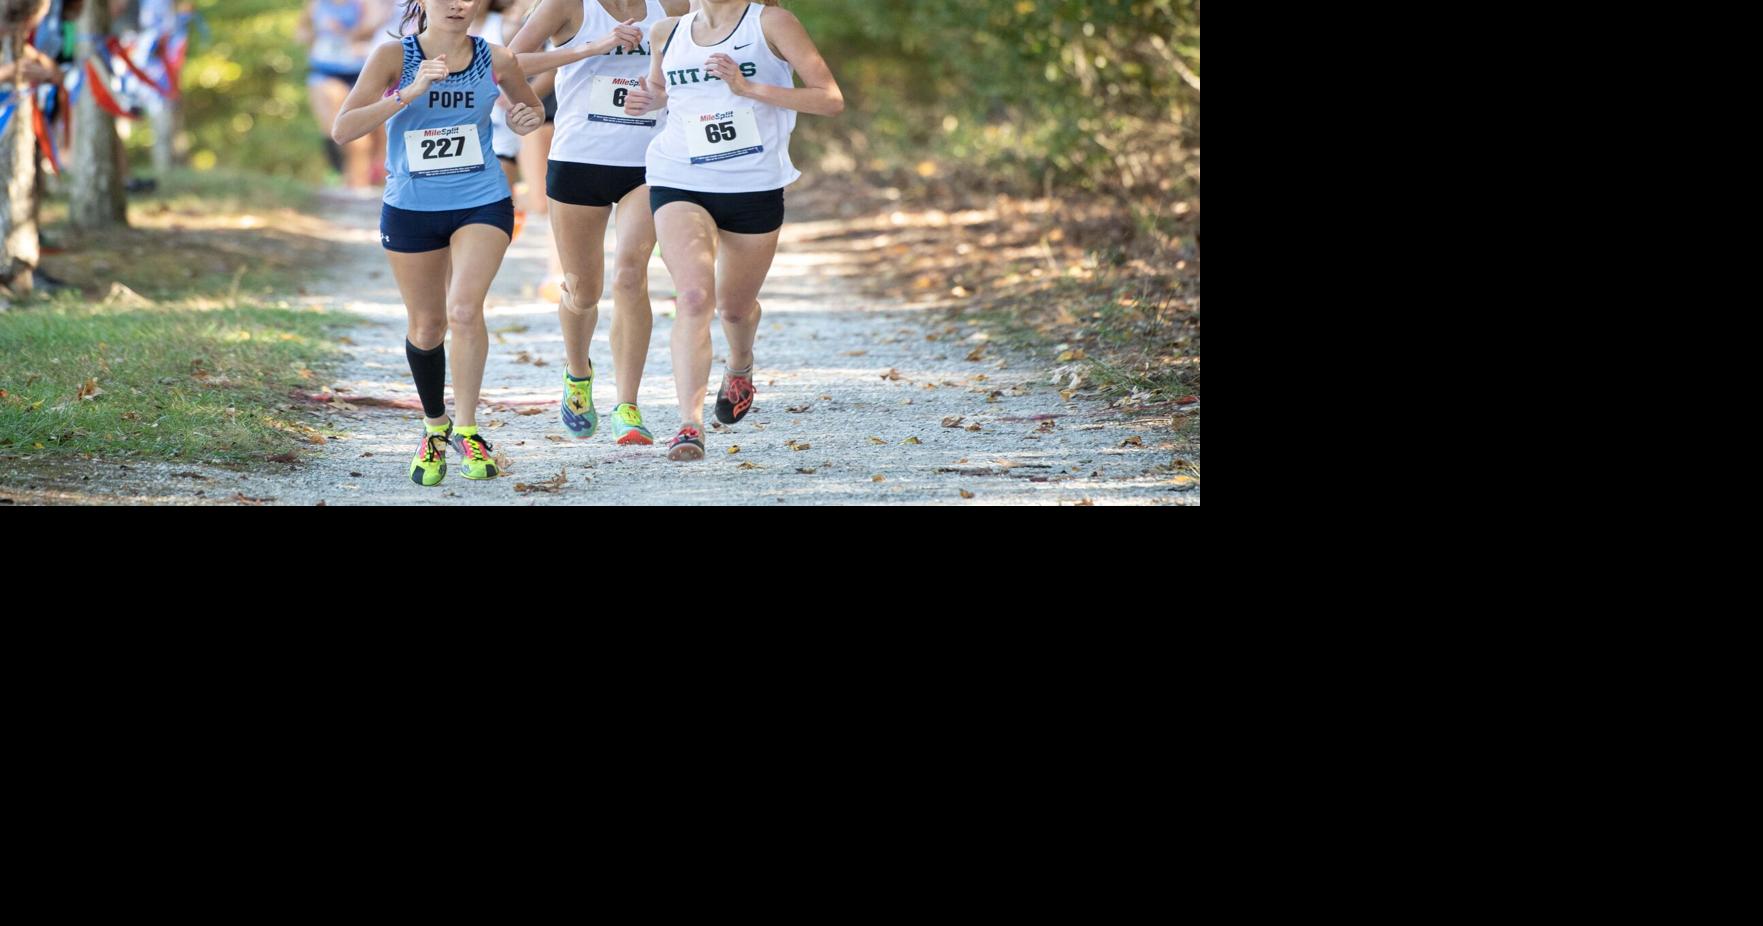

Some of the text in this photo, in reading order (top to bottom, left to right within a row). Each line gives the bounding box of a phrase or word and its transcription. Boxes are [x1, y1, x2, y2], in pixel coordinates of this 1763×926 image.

[612, 78, 639, 87] MileSp
[666, 62, 756, 85] TITAS
[429, 91, 474, 108] POPE
[613, 88, 628, 107] 6
[700, 111, 733, 121] MileSplit
[424, 127, 459, 136] MileSplit
[705, 121, 736, 143] 65
[421, 136, 465, 159] 227
